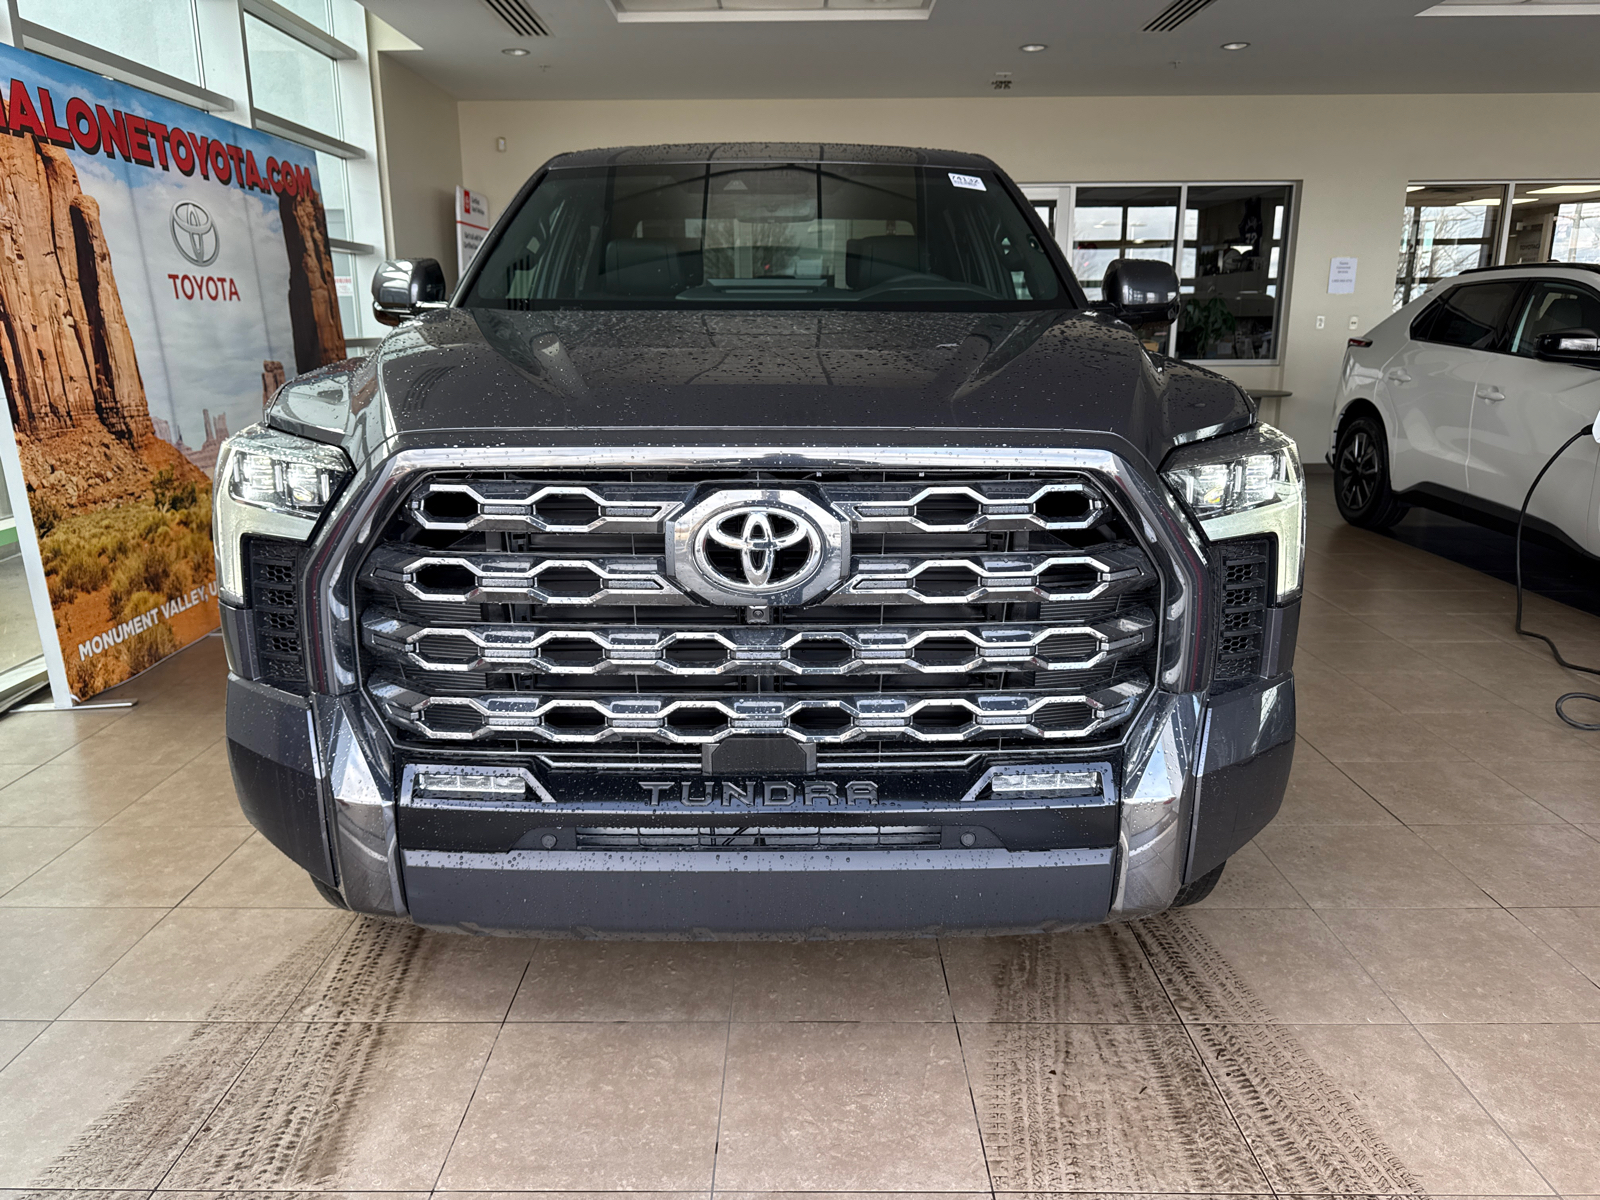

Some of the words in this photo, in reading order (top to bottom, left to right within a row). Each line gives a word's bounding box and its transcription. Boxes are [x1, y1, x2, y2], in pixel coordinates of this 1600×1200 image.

[168, 273, 241, 301] TOYOTA
[78, 606, 159, 661] MONUMENT
[160, 585, 209, 619] VALLEY,
[638, 780, 879, 806] TUNDRA
